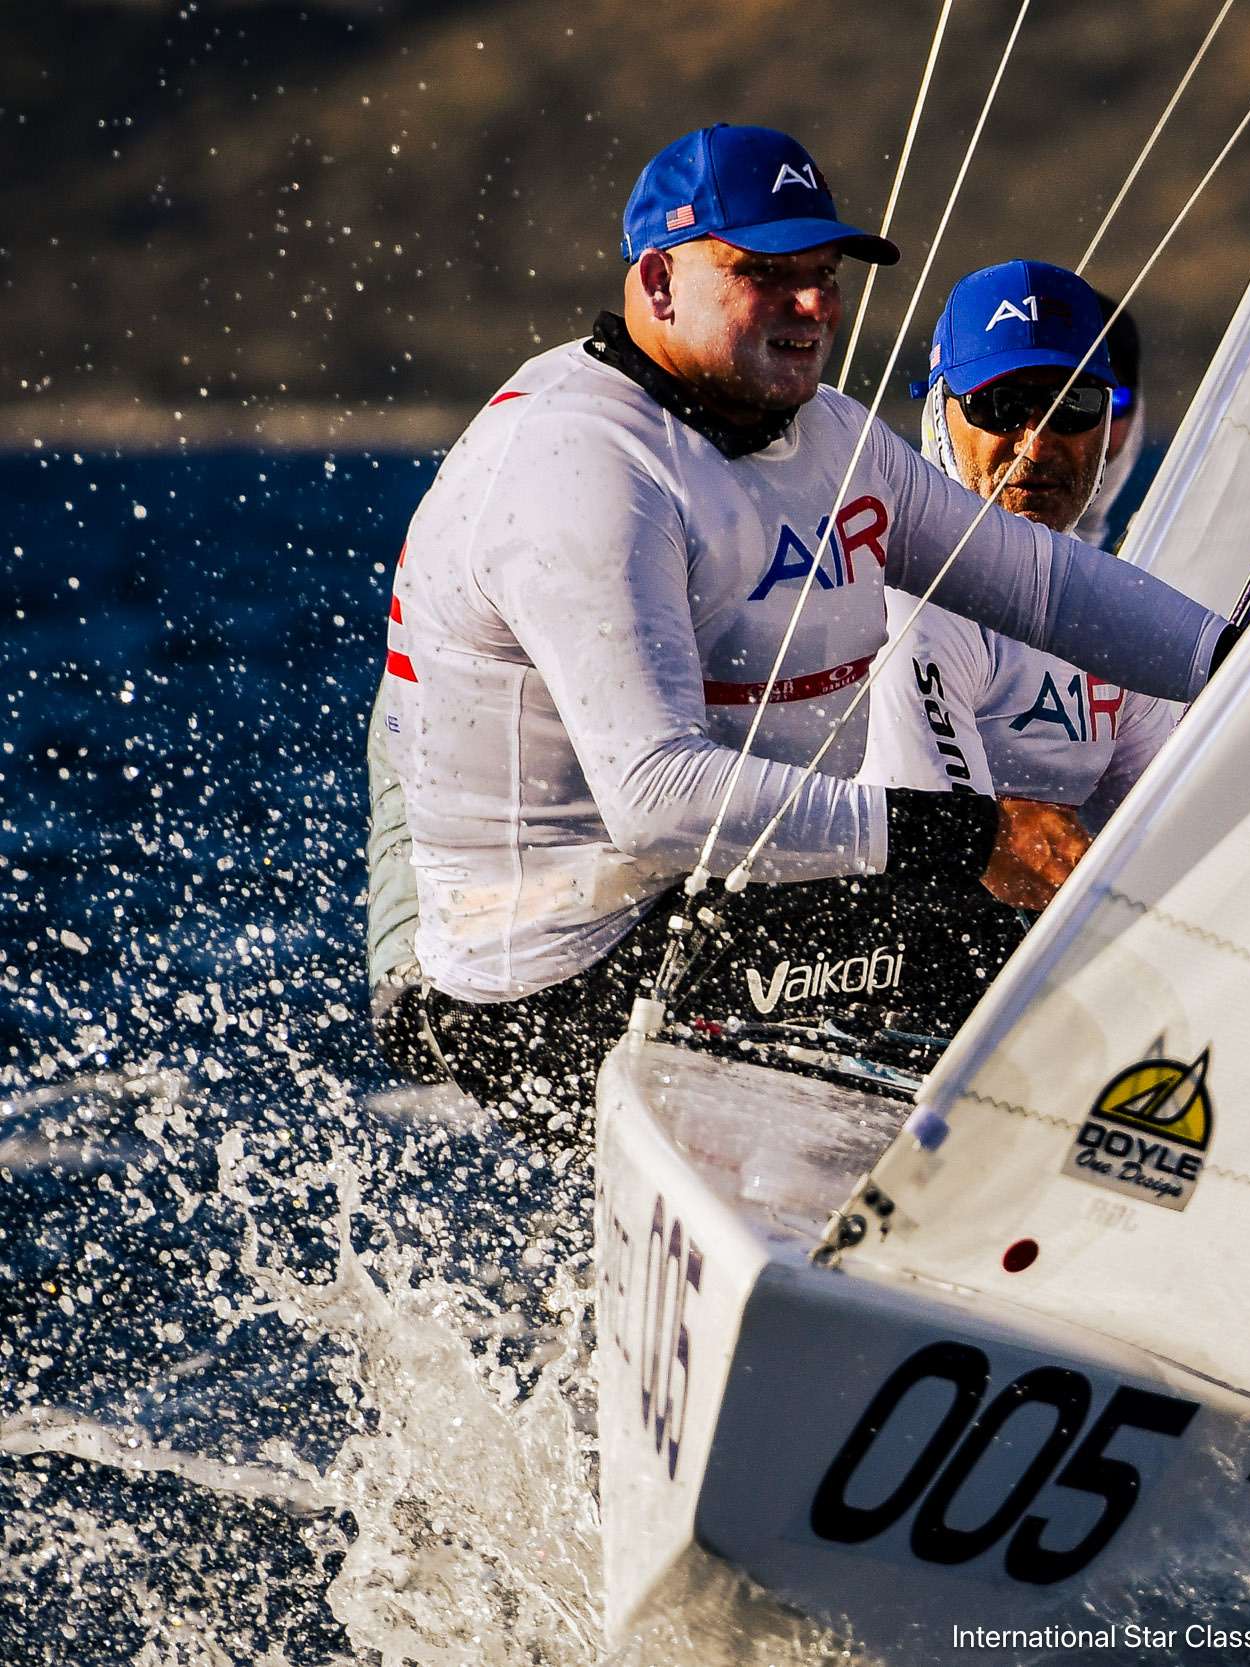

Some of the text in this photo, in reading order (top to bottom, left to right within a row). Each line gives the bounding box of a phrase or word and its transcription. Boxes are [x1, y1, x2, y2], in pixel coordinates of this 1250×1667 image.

[746, 943, 906, 1014] Vaikobi
[1076, 1149, 1184, 1198] One Design
[1077, 1121, 1203, 1181] DOYLE
[809, 1340, 1200, 1586] 005
